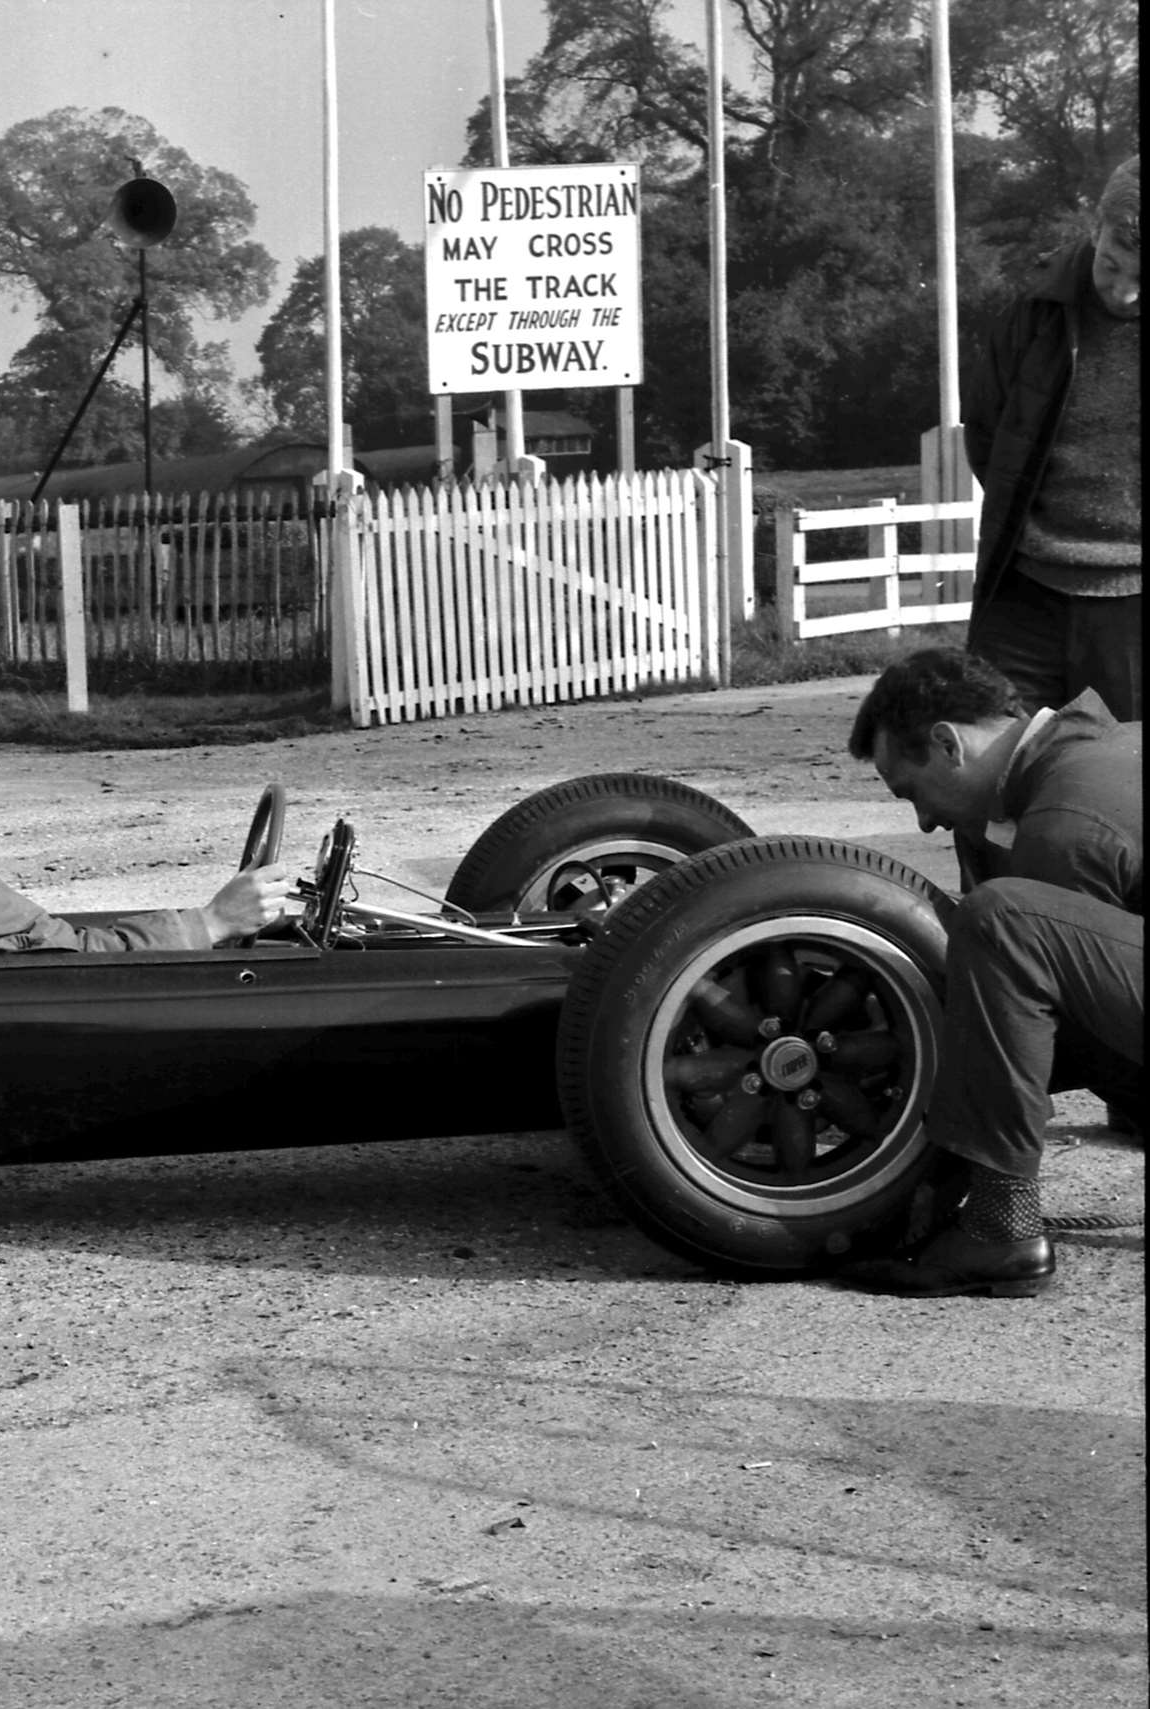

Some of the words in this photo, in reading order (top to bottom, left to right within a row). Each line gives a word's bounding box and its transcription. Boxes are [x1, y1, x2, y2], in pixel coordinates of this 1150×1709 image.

[481, 181, 638, 221] PEDESTRIAN
[442, 236, 498, 261] MAY
[528, 231, 613, 258] CROSS
[454, 277, 508, 302] THE
[526, 273, 618, 299] TRACK
[434, 312, 498, 333] EXCEPT
[508, 308, 581, 330] THROUGH
[592, 307, 622, 327] THE
[471, 340, 608, 375] SUBWAY.
